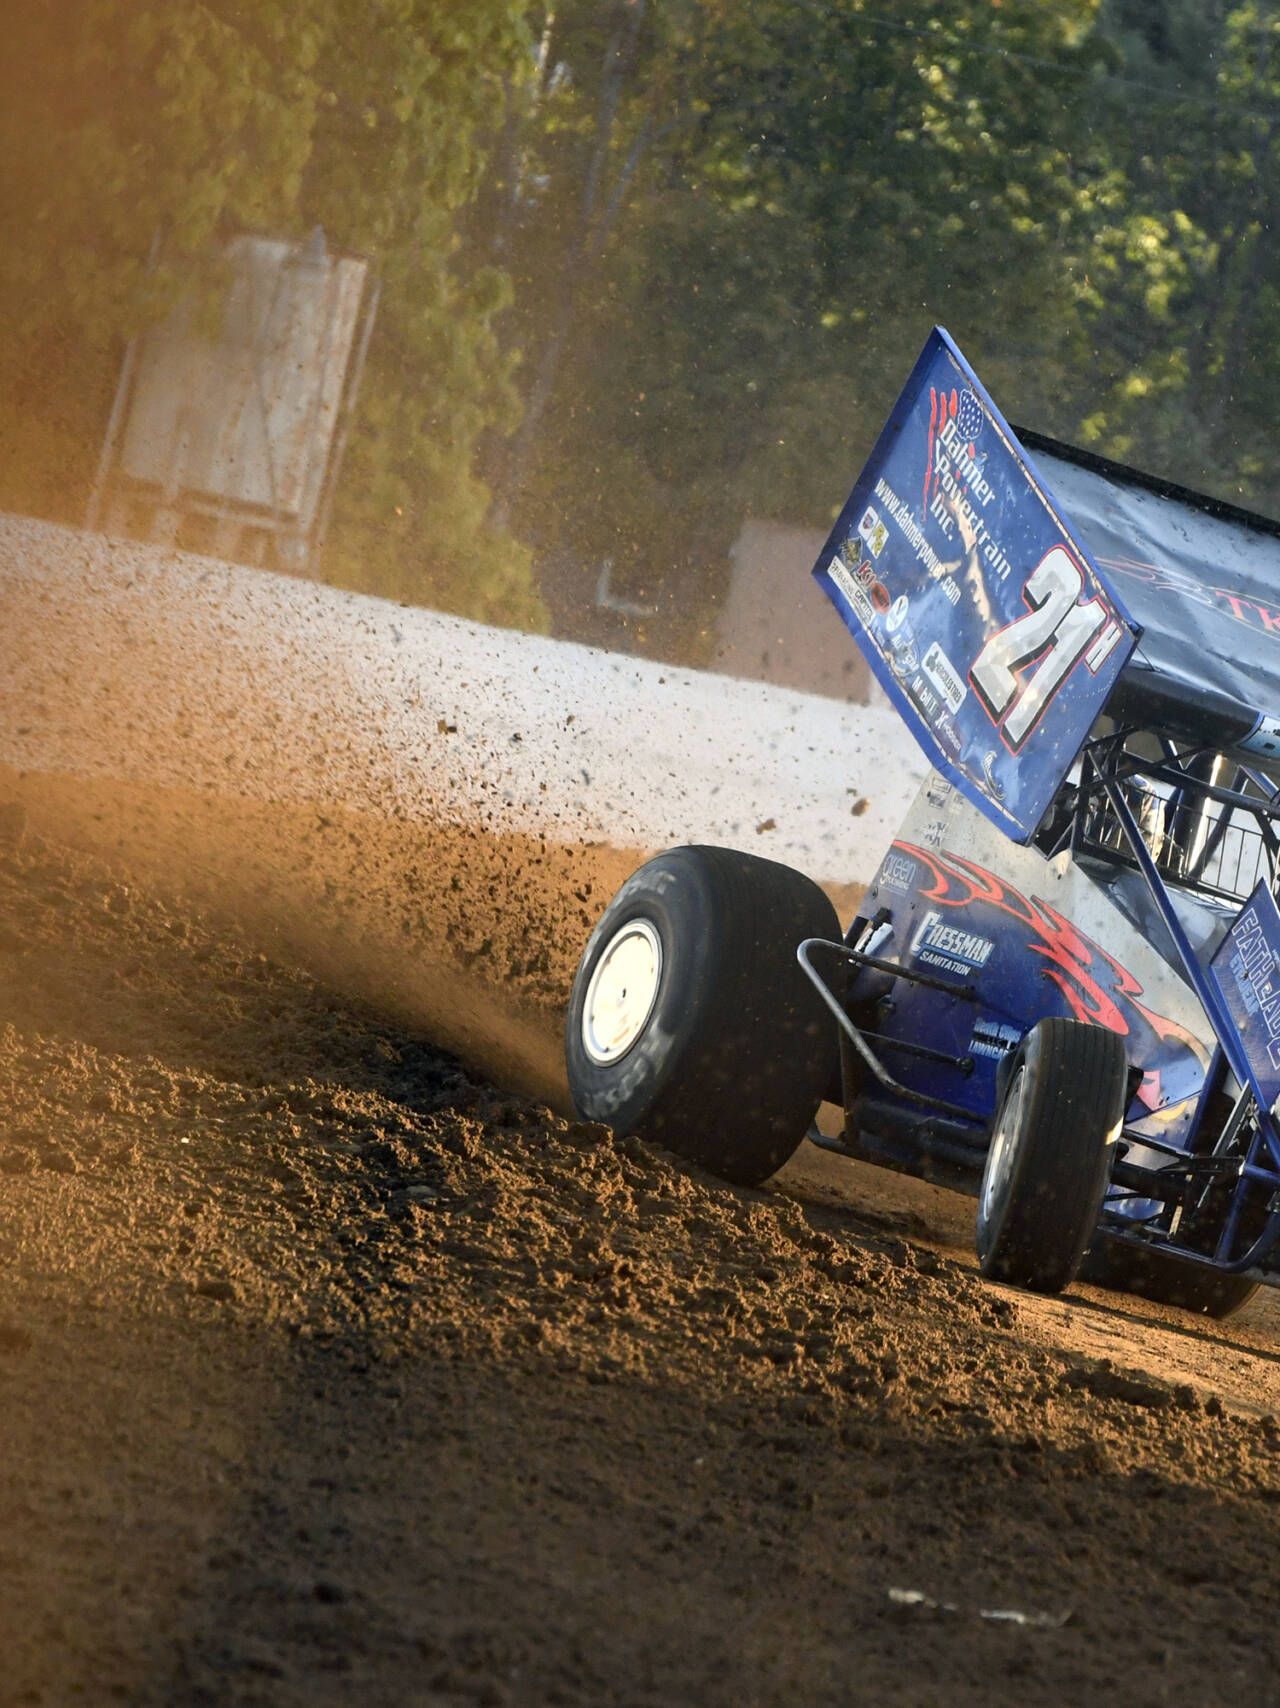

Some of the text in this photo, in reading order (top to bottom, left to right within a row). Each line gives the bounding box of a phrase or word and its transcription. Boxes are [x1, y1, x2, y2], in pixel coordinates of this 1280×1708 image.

[940, 419, 996, 507] Dahmer
[874, 477, 962, 606] www.dahmerpower.com
[930, 493, 954, 541] Inc.
[934, 448, 1012, 581] Powertrain
[911, 911, 993, 963] CRESSMAN
[920, 951, 971, 976] SANITATION
